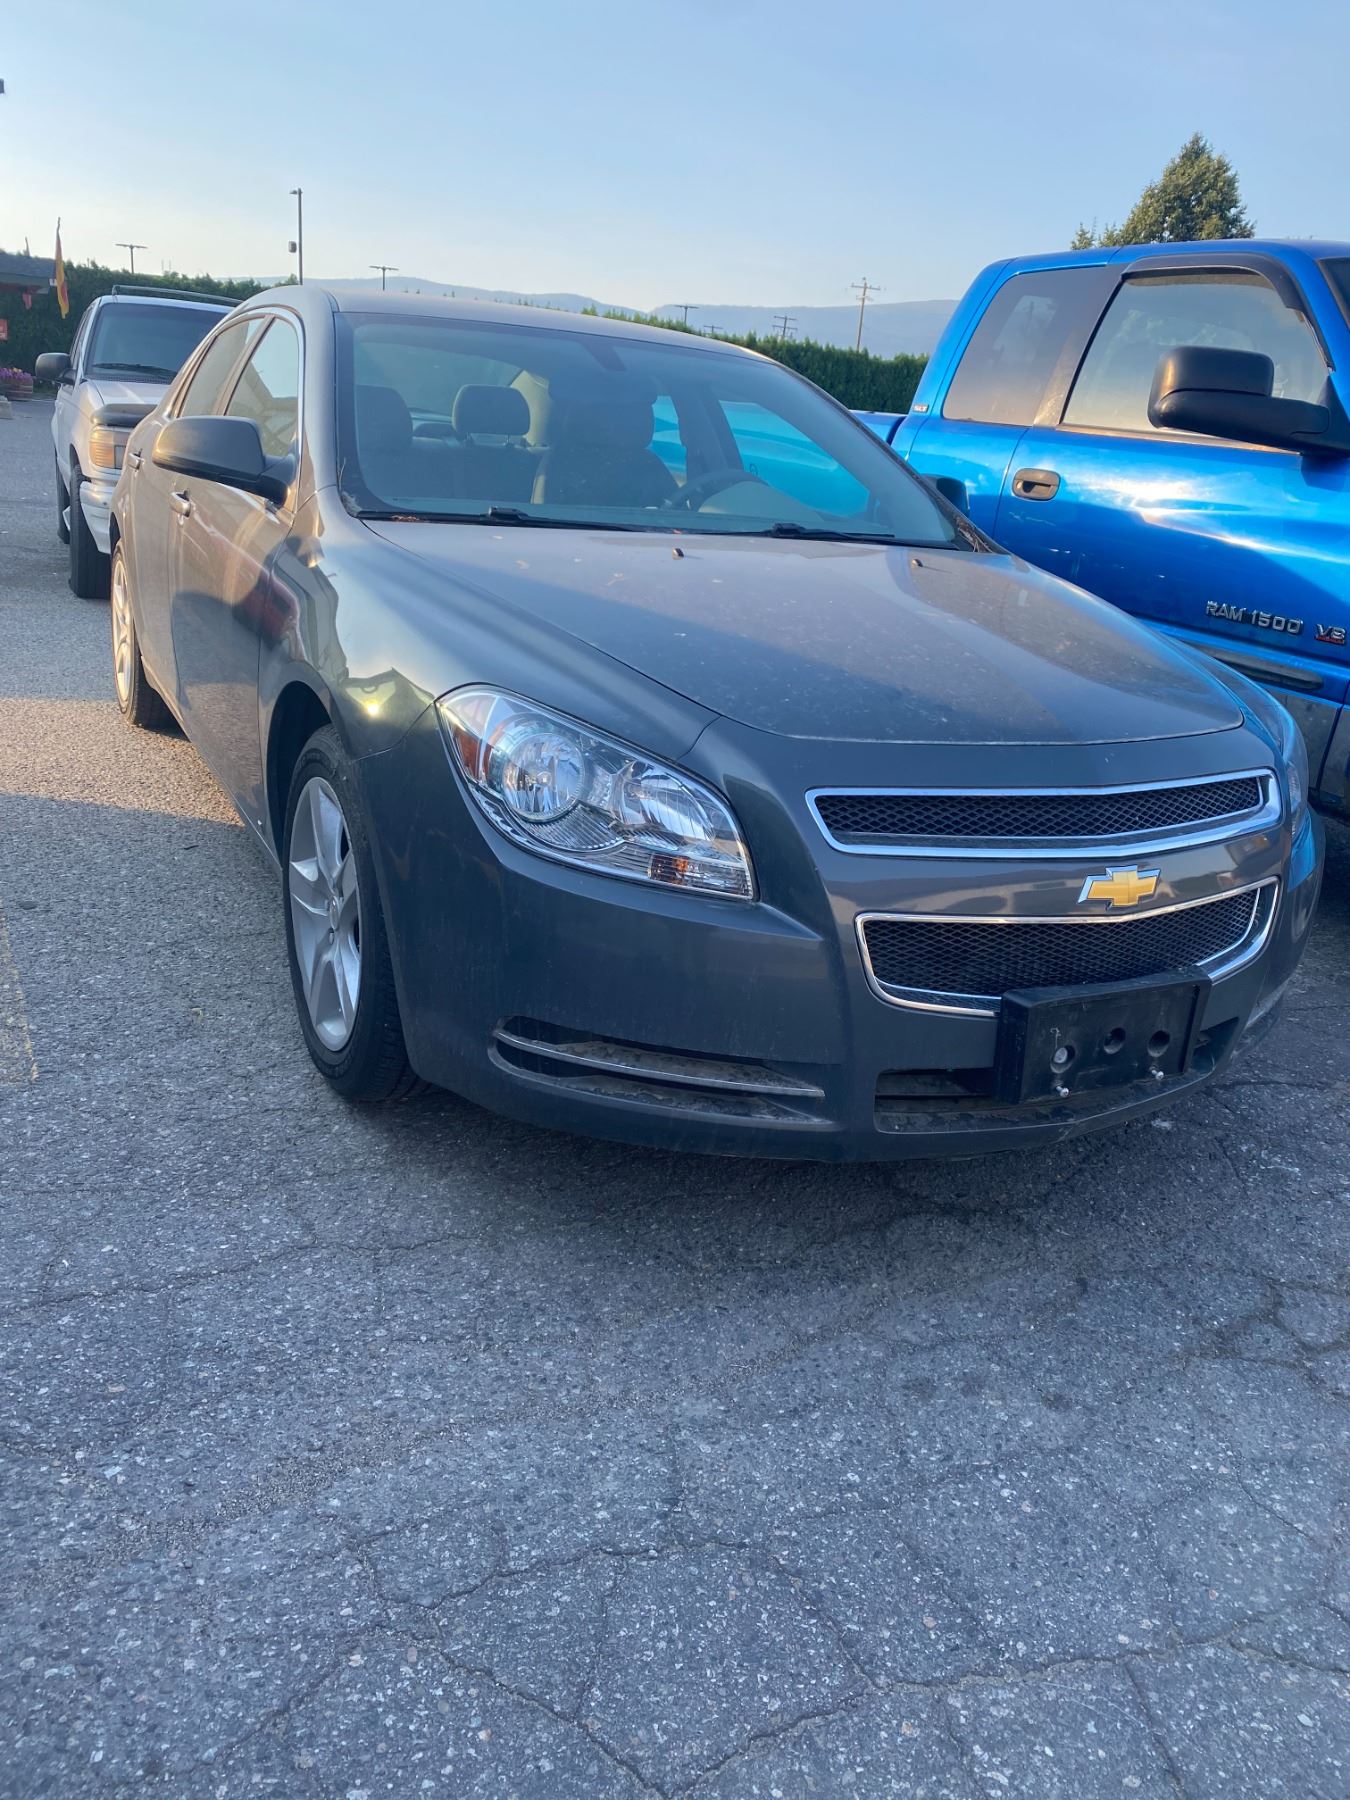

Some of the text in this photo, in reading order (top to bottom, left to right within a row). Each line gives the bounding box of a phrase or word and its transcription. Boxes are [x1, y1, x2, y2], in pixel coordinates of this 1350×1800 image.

[1206, 600, 1246, 622] RAM
[1251, 609, 1304, 634] 1500
[1316, 623, 1346, 640] V8
